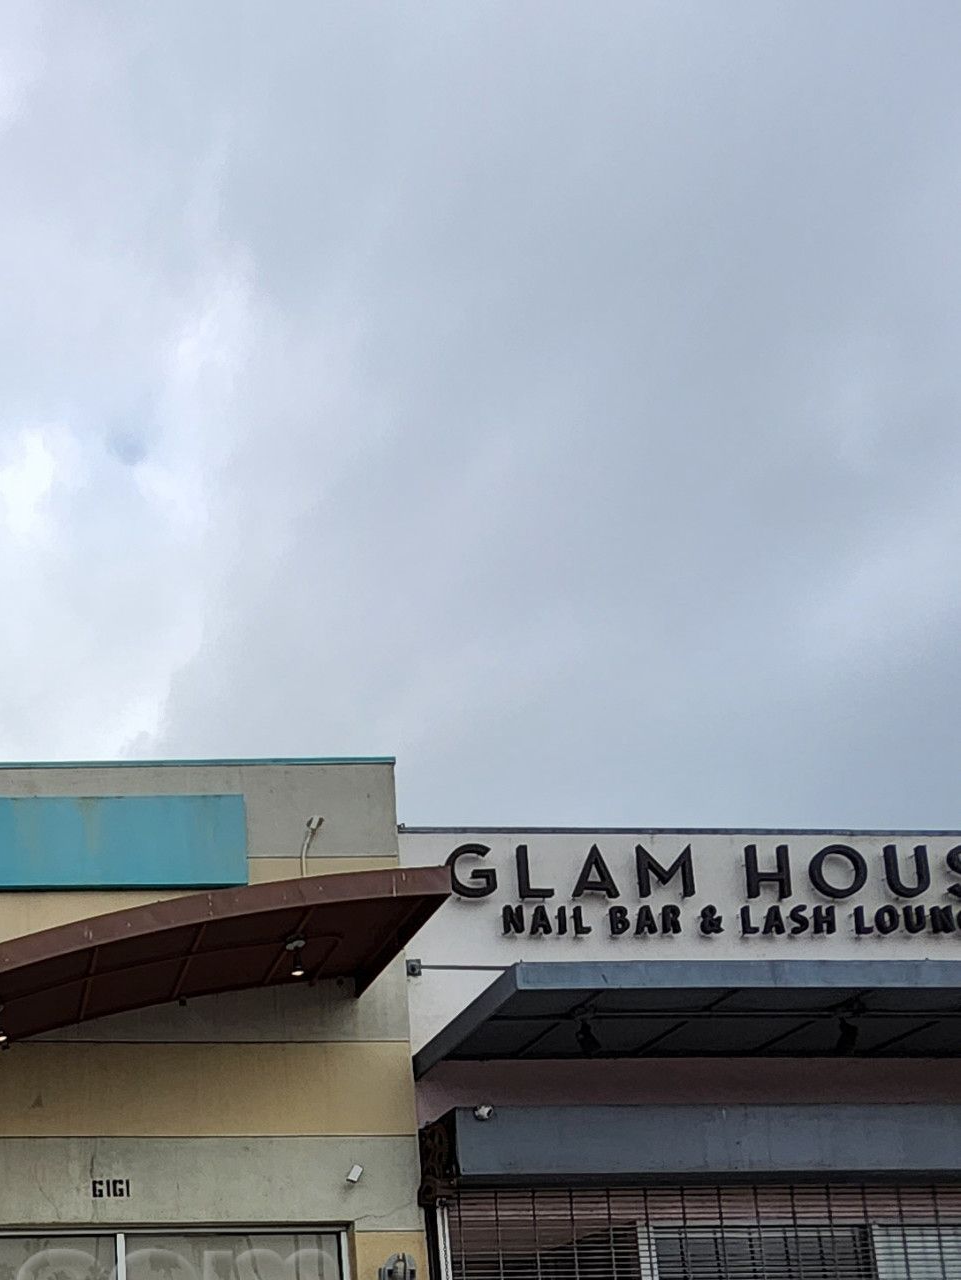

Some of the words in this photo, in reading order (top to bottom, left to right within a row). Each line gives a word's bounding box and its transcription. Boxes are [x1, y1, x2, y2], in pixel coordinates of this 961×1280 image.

[446, 843, 696, 899] GLAM
[501, 904, 592, 935] NAIL
[608, 904, 681, 935] BAR
[700, 904, 724, 935] &
[740, 905, 836, 935] LASH
[853, 904, 961, 935] LOUN
